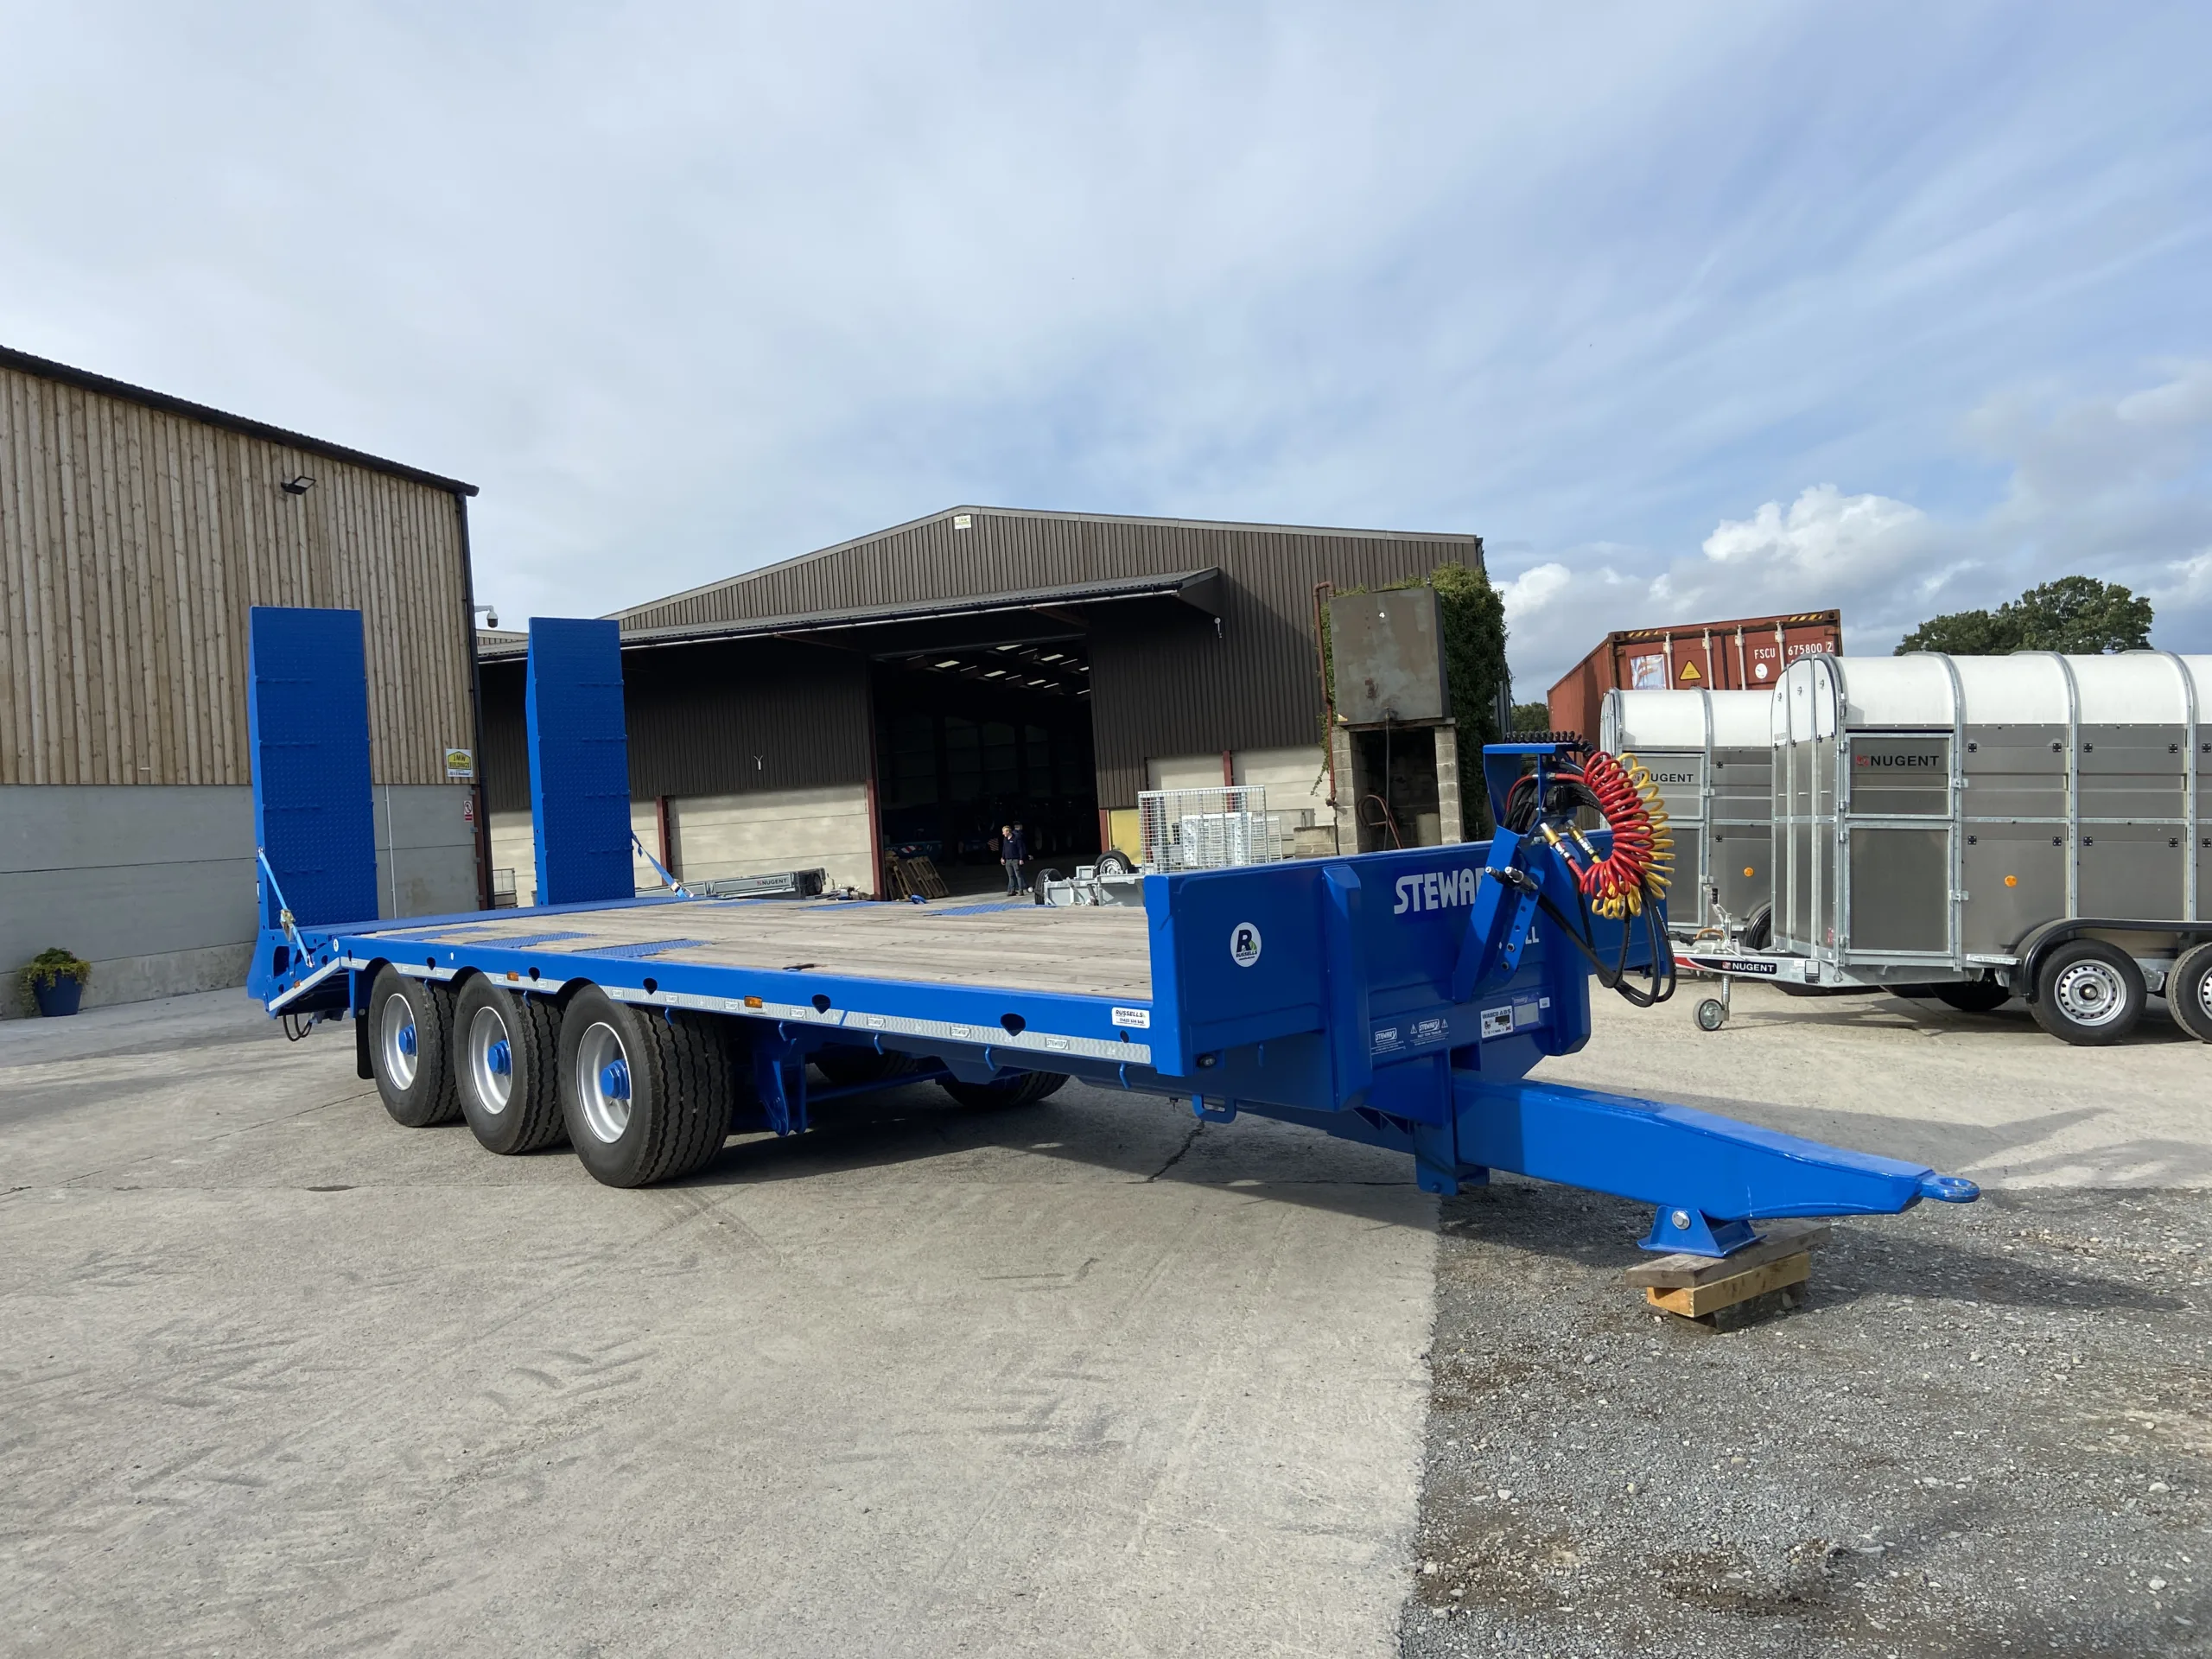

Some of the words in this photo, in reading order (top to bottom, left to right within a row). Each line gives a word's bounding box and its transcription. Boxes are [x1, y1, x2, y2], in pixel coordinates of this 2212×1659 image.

[1754, 648, 1776, 659] FSCU
[1788, 643, 1822, 656] 675800
[1827, 641, 1834, 652] 2
[1870, 755, 1940, 766] NUGENT
[1732, 963, 1775, 972] NUGENT
[1376, 1030, 1395, 1040] STEWART
